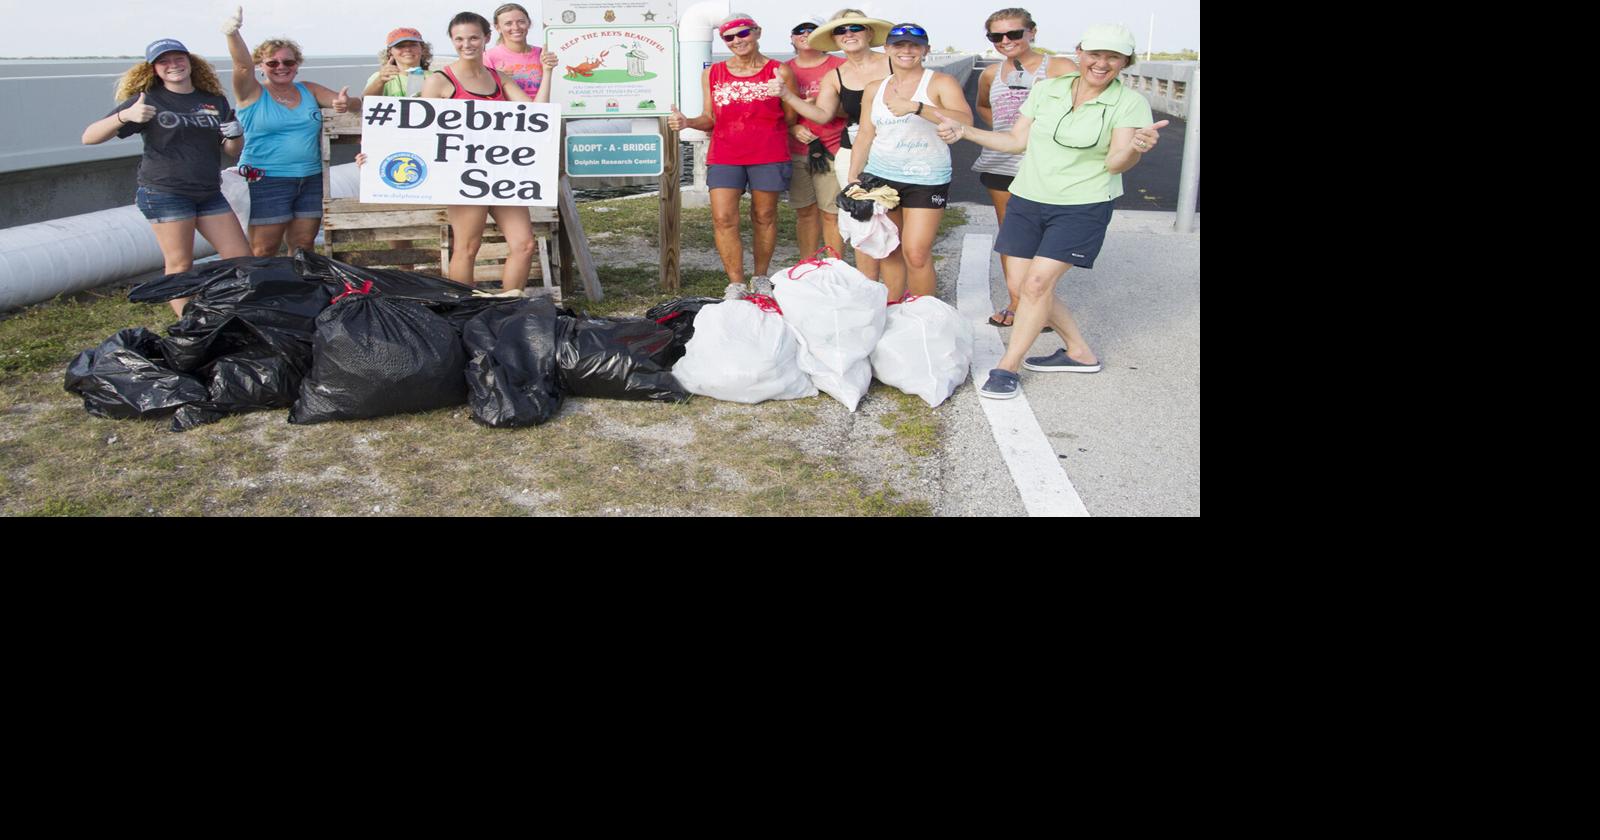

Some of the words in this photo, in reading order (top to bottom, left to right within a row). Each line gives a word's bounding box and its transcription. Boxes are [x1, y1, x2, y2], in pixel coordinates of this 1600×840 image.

[561, 37, 580, 52] KEEP
[581, 32, 598, 40] THE
[624, 31, 665, 53] BEAUTIFUL
[365, 99, 549, 133] #Debris
[434, 133, 536, 166] Free
[572, 144, 602, 152] ADOPT
[609, 144, 616, 152] A
[623, 143, 656, 151] BRIDGE
[459, 168, 543, 200] Sea
